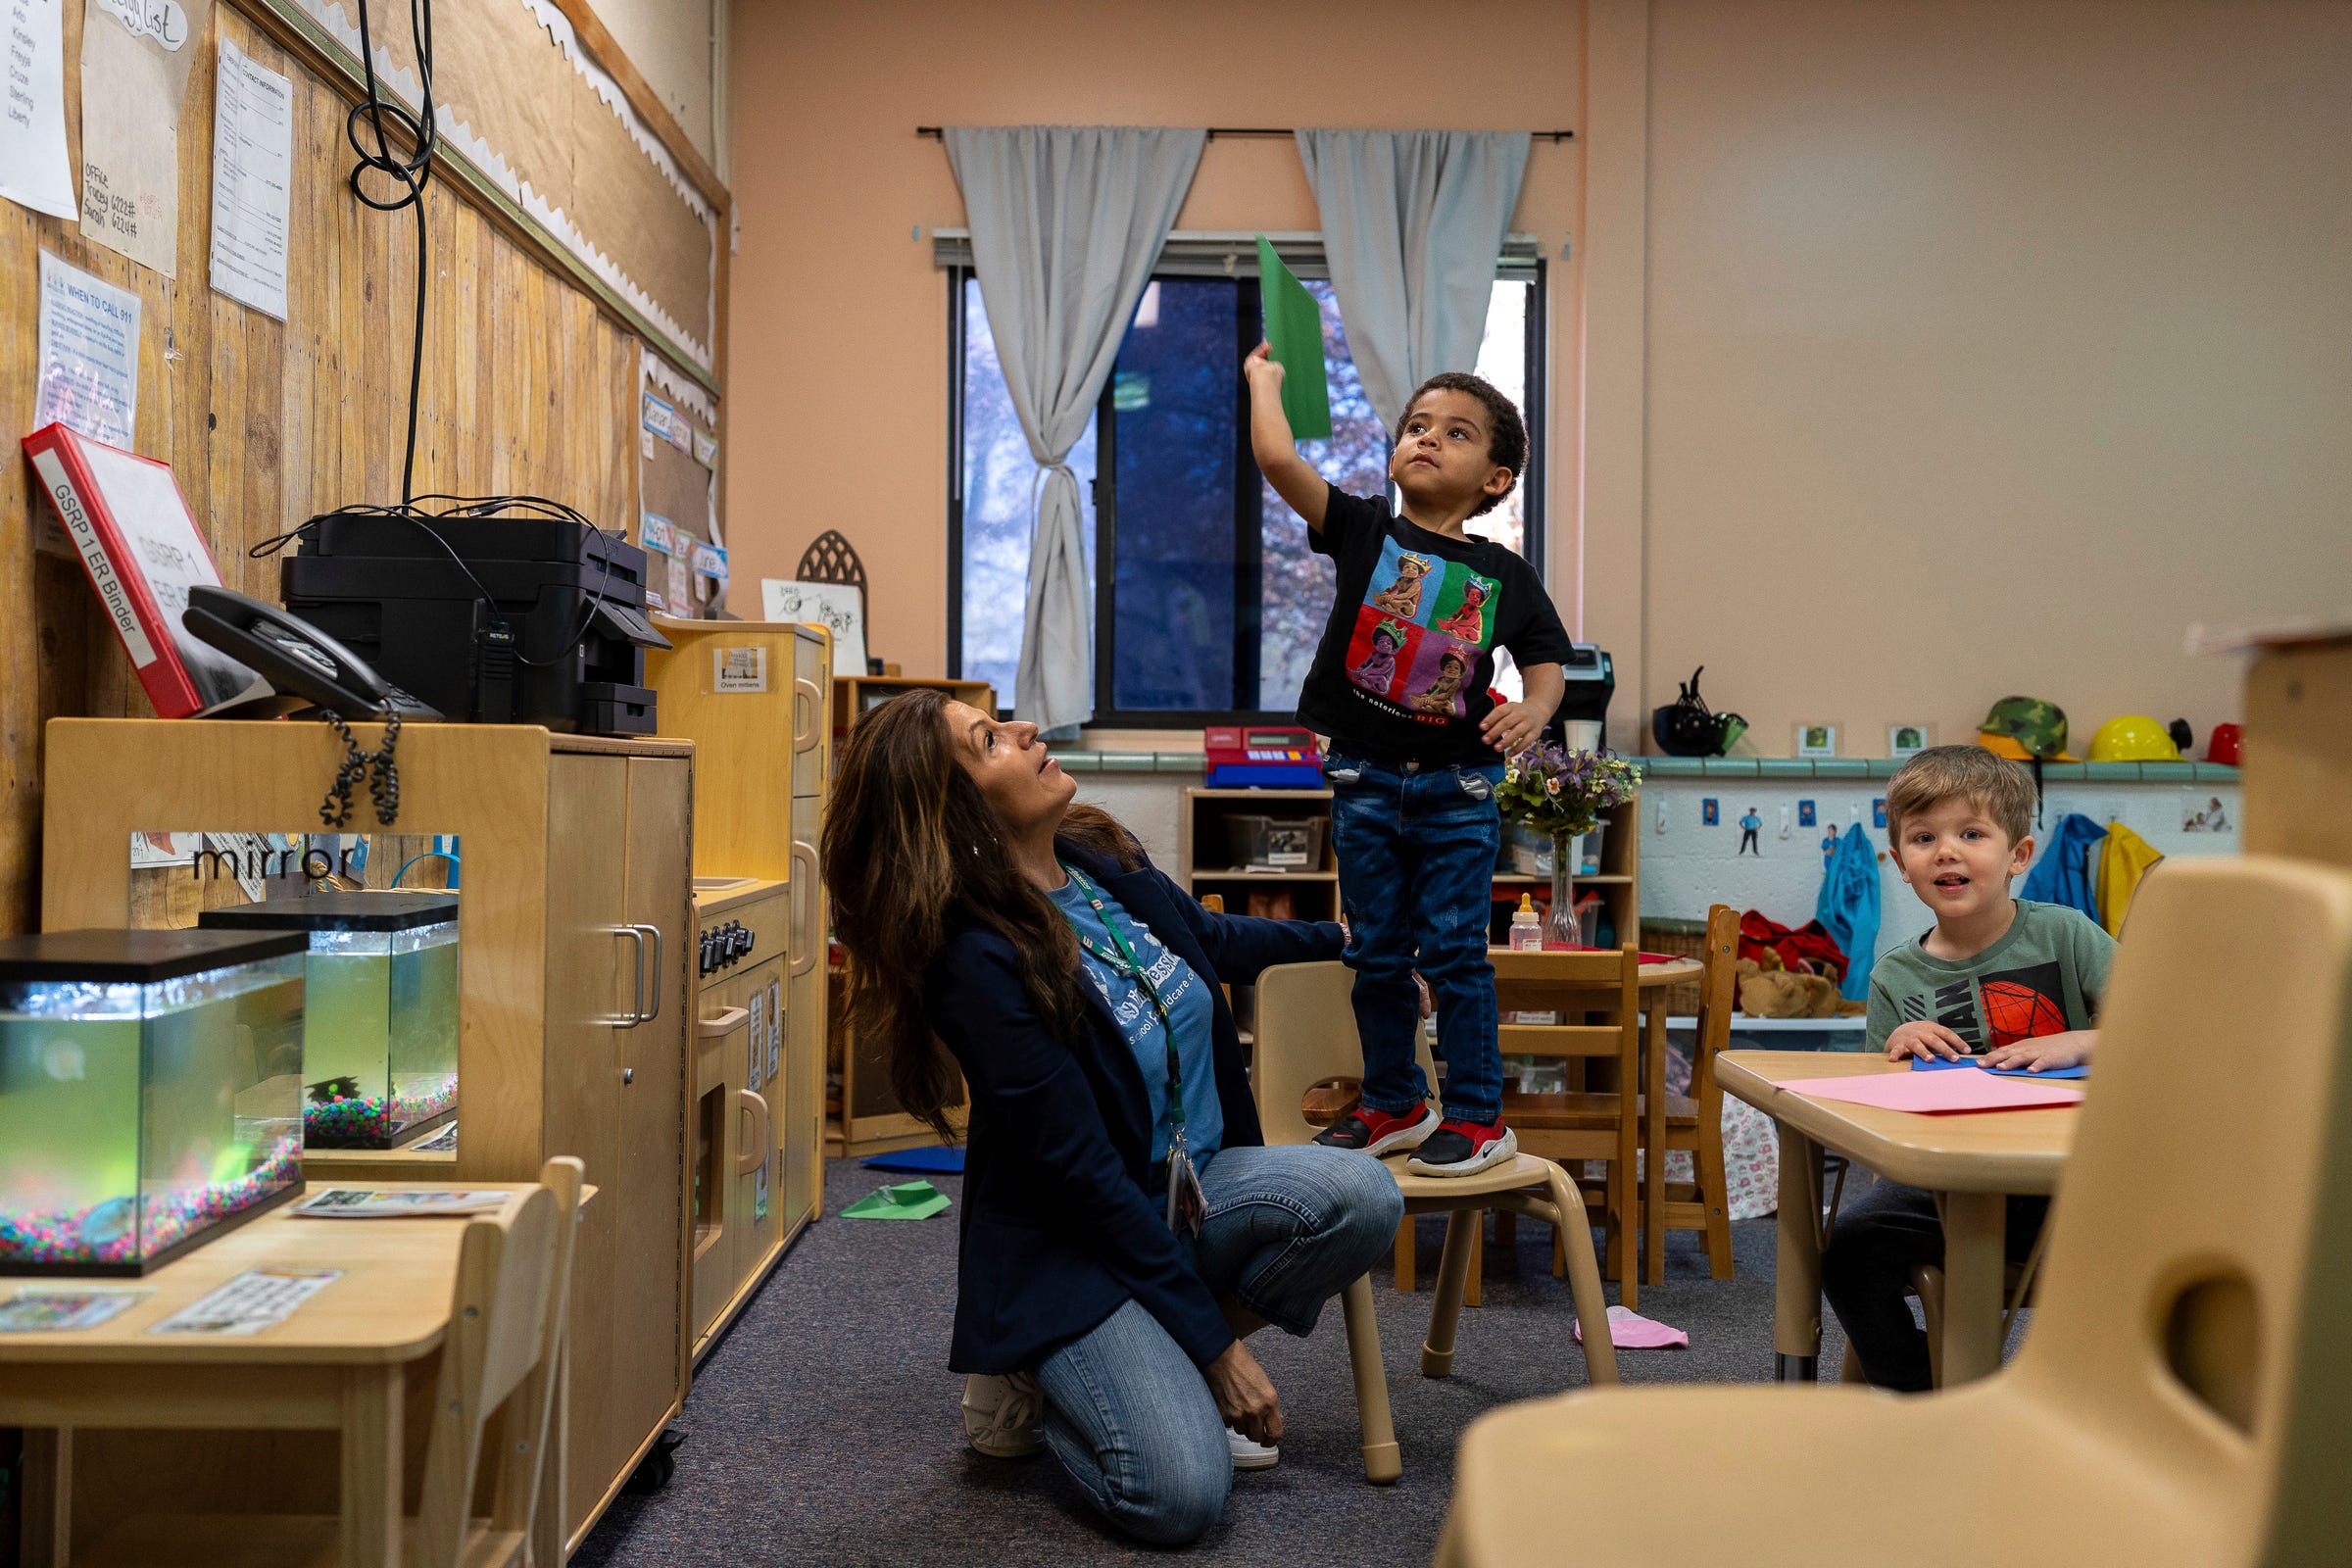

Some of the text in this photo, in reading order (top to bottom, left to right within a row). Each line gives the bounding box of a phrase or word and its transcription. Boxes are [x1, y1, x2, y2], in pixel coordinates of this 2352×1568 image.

[144, 0, 179, 43] list
[68, 283, 89, 304] WHEN
[90, 295, 101, 309] TO
[102, 300, 120, 318] CALL
[121, 309, 132, 324] 911
[54, 483, 90, 533] GSRP
[87, 551, 111, 578] ER
[102, 579, 136, 636] Binder
[1416, 714, 1446, 724] BIG
[194, 839, 355, 880] mirror
